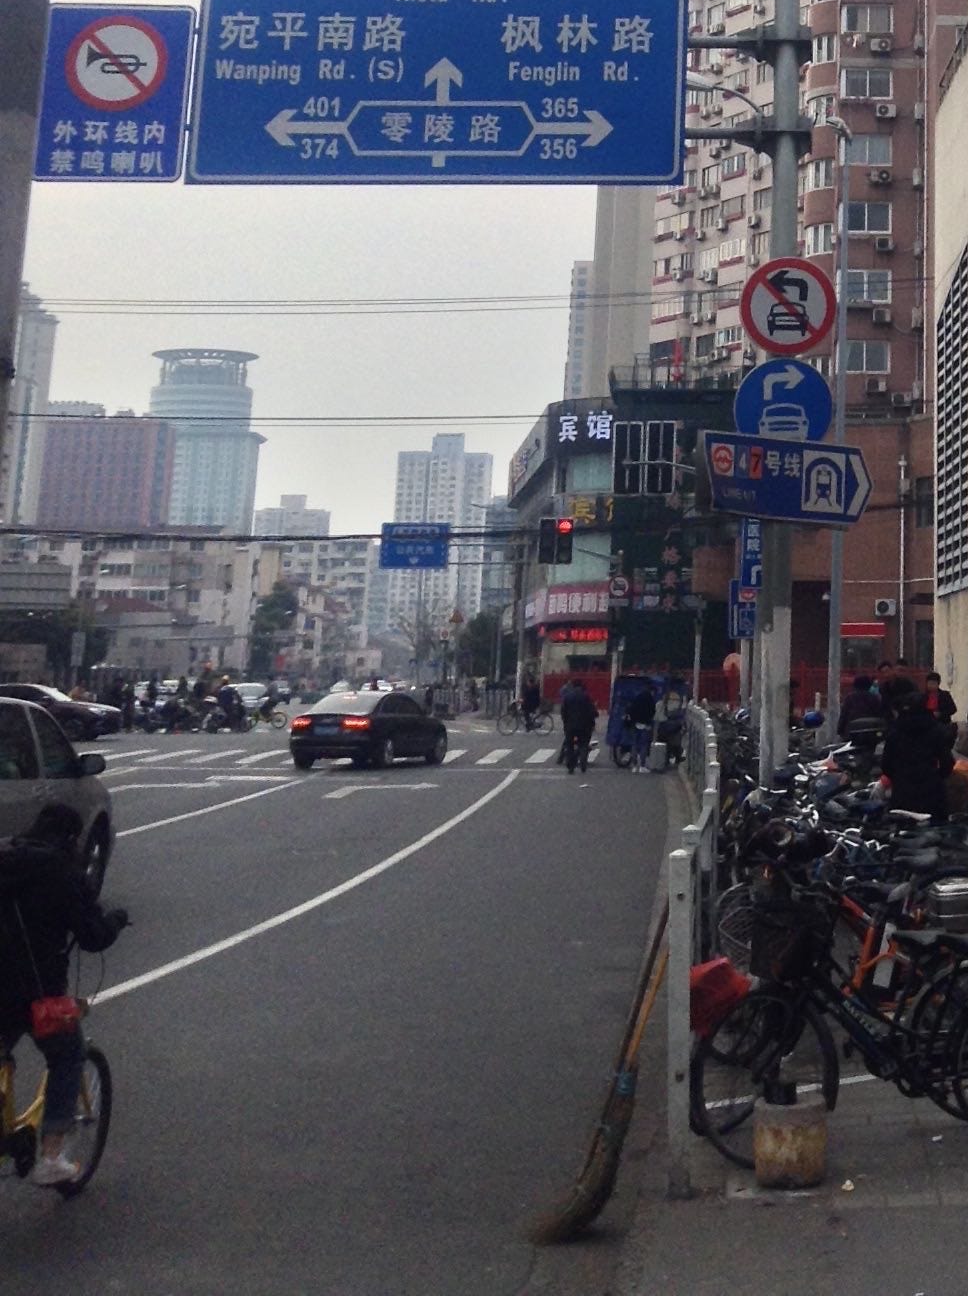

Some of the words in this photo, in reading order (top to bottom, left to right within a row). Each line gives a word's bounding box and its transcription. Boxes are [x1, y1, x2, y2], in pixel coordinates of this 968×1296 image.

[218, 11, 406, 52] 宛平南路
[500, 14, 655, 54] 枫林路
[215, 58, 301, 86] Wanping
[318, 58, 356, 80] Rd.
[368, 56, 405, 83] (S)
[508, 61, 581, 86] Fenglin
[603, 61, 639, 82] Rd.
[302, 96, 341, 118] 401
[541, 97, 579, 119] 365
[53, 120, 167, 146] 外环线内
[381, 112, 502, 144] 零陵路
[300, 138, 340, 160] 374
[539, 138, 578, 160] 356
[50, 150, 164, 175] 禁鸣喇叭
[558, 410, 613, 443] 宾馆
